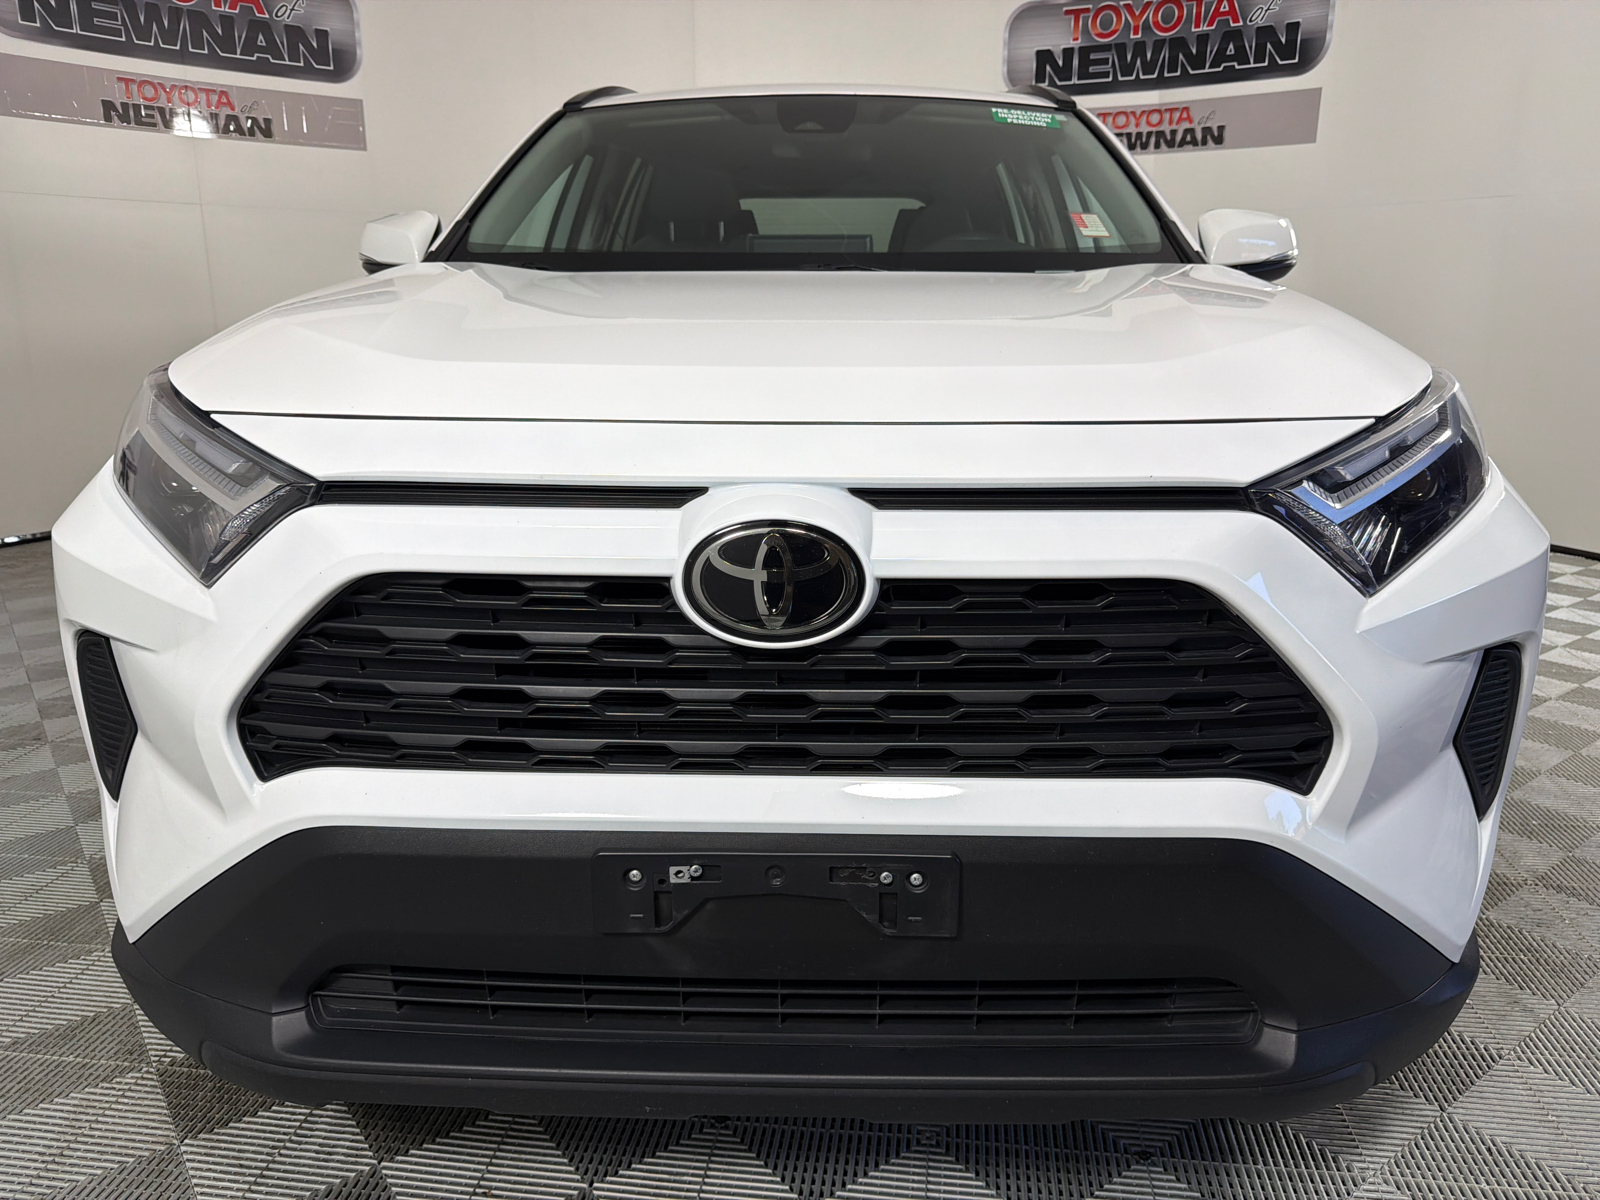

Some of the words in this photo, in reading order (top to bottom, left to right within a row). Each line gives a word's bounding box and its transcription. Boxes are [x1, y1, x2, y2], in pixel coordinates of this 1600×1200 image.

[1064, 0, 1242, 43] TOYOTA
[1248, 0, 1281, 24] of
[16, 0, 334, 70] NEWNAN
[1034, 20, 1301, 84] NEWNAN
[116, 76, 236, 112] TOYOTA
[240, 101, 258, 115] of
[991, 107, 1052, 118] PRE-DELIVERY
[998, 113, 1052, 123] INSPECTION
[1007, 118, 1047, 127] PENDING
[1097, 106, 1194, 130] TOYOTA
[1197, 110, 1216, 125] of
[1114, 125, 1226, 151] WNAN
